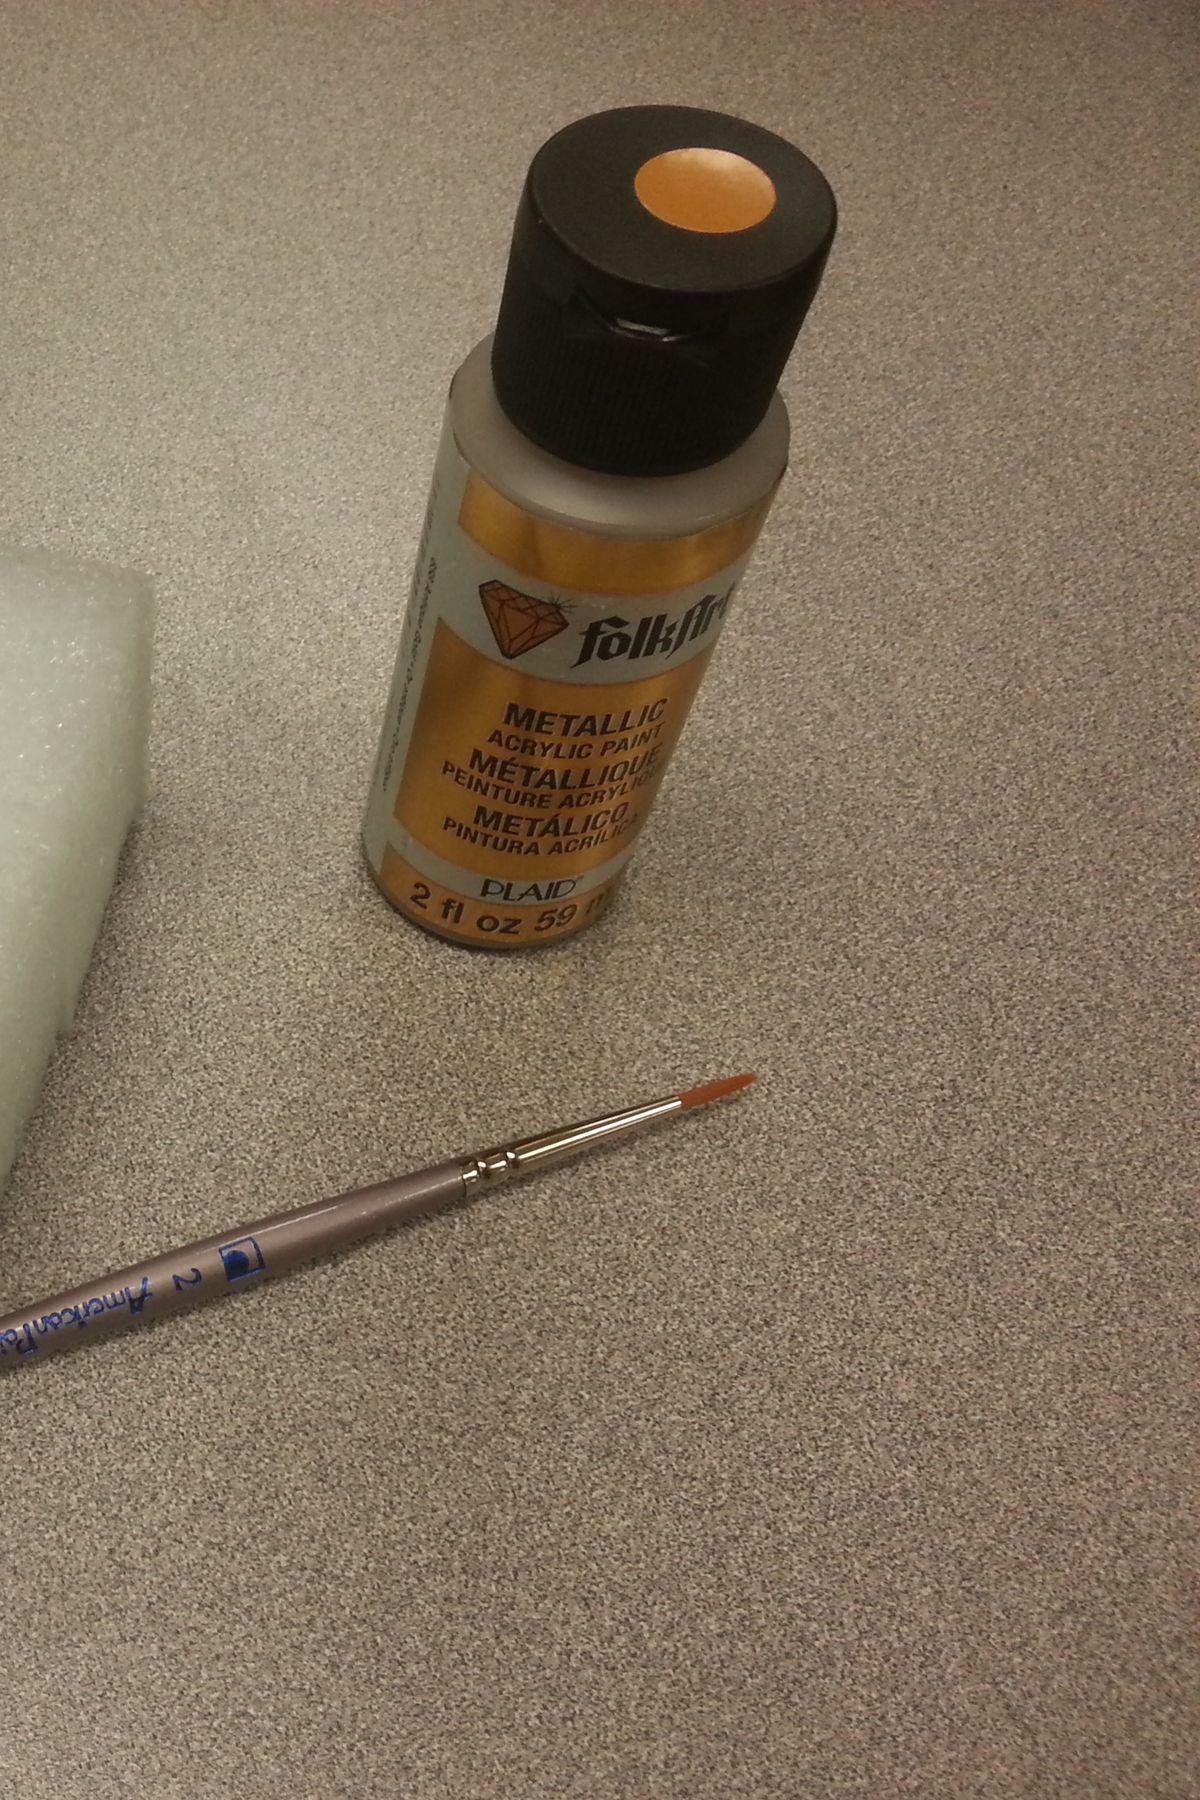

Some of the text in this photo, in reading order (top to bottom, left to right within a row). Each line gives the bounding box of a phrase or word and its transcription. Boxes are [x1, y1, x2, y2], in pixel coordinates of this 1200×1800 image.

[503, 698, 668, 737] METALLIC
[487, 722, 665, 760] ACRYLIC PAINT
[442, 760, 552, 809] PEINTURE
[468, 748, 664, 790] MÉTALLIQUE
[443, 816, 540, 856] PINTURA
[473, 802, 629, 838] METÁLICO
[409, 882, 432, 910] 2
[440, 897, 464, 924] fl
[476, 914, 523, 935] oz
[534, 903, 578, 932] 59
[480, 877, 577, 902] PLAID
[172, 1267, 202, 1291] 2
[32, 1276, 152, 1334] American
